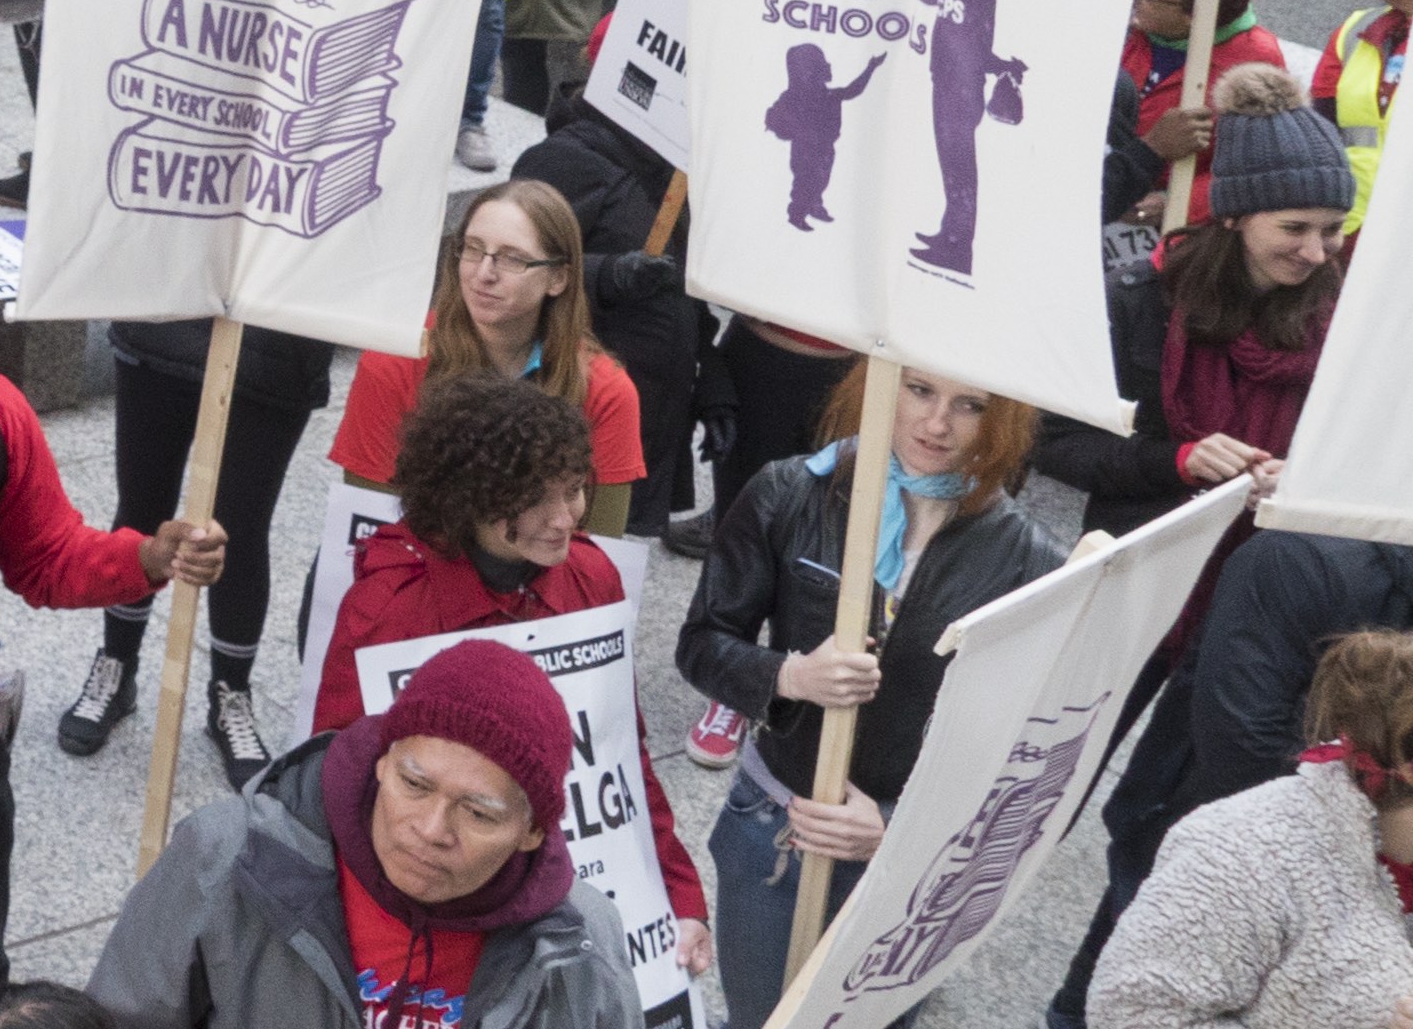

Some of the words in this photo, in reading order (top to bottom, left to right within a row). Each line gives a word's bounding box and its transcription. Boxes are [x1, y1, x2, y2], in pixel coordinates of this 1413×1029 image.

[199, 2, 303, 88] NURSE
[121, 74, 144, 100] IN
[153, 83, 214, 122] EVERY
[214, 95, 273, 141] SCHOOL
[131, 146, 245, 206] EVERY
[246, 161, 308, 216] DAY
[1118, 229, 1157, 255] 73
[535, 647, 571, 672] BLIC
[572, 635, 624, 668] SCHOOLS
[574, 858, 605, 880] ara
